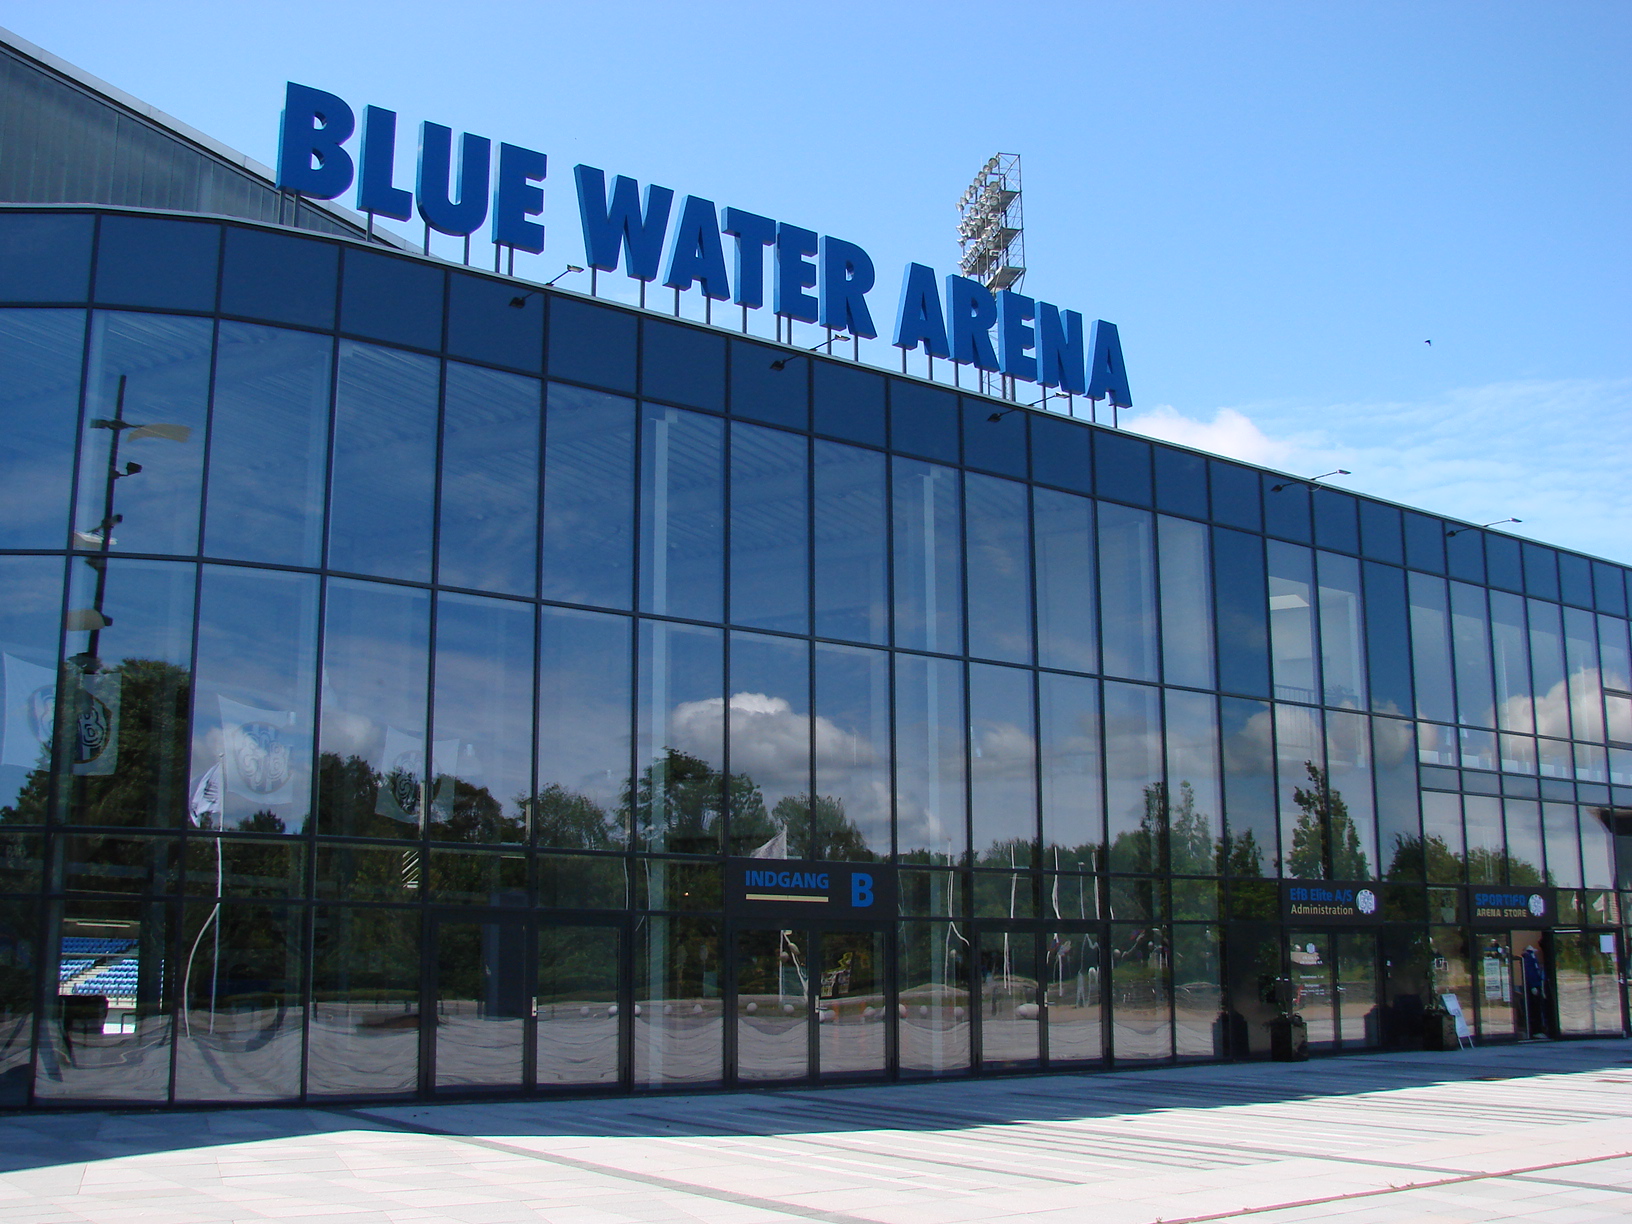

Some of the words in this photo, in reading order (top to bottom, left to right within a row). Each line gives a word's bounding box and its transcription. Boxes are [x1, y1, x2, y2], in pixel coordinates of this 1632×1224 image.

[276, 81, 547, 254] BLUE
[573, 164, 878, 339] WATER
[892, 262, 1133, 408] ARENA
[745, 870, 829, 889] INDGANG
[852, 873, 874, 907] B
[1290, 888, 1308, 901] EfB
[1310, 888, 1333, 902] Elite
[1335, 889, 1353, 904] A/S
[1291, 904, 1353, 915] Administration
[1477, 908, 1501, 917] ARENA
[1504, 909, 1528, 917] STORE
